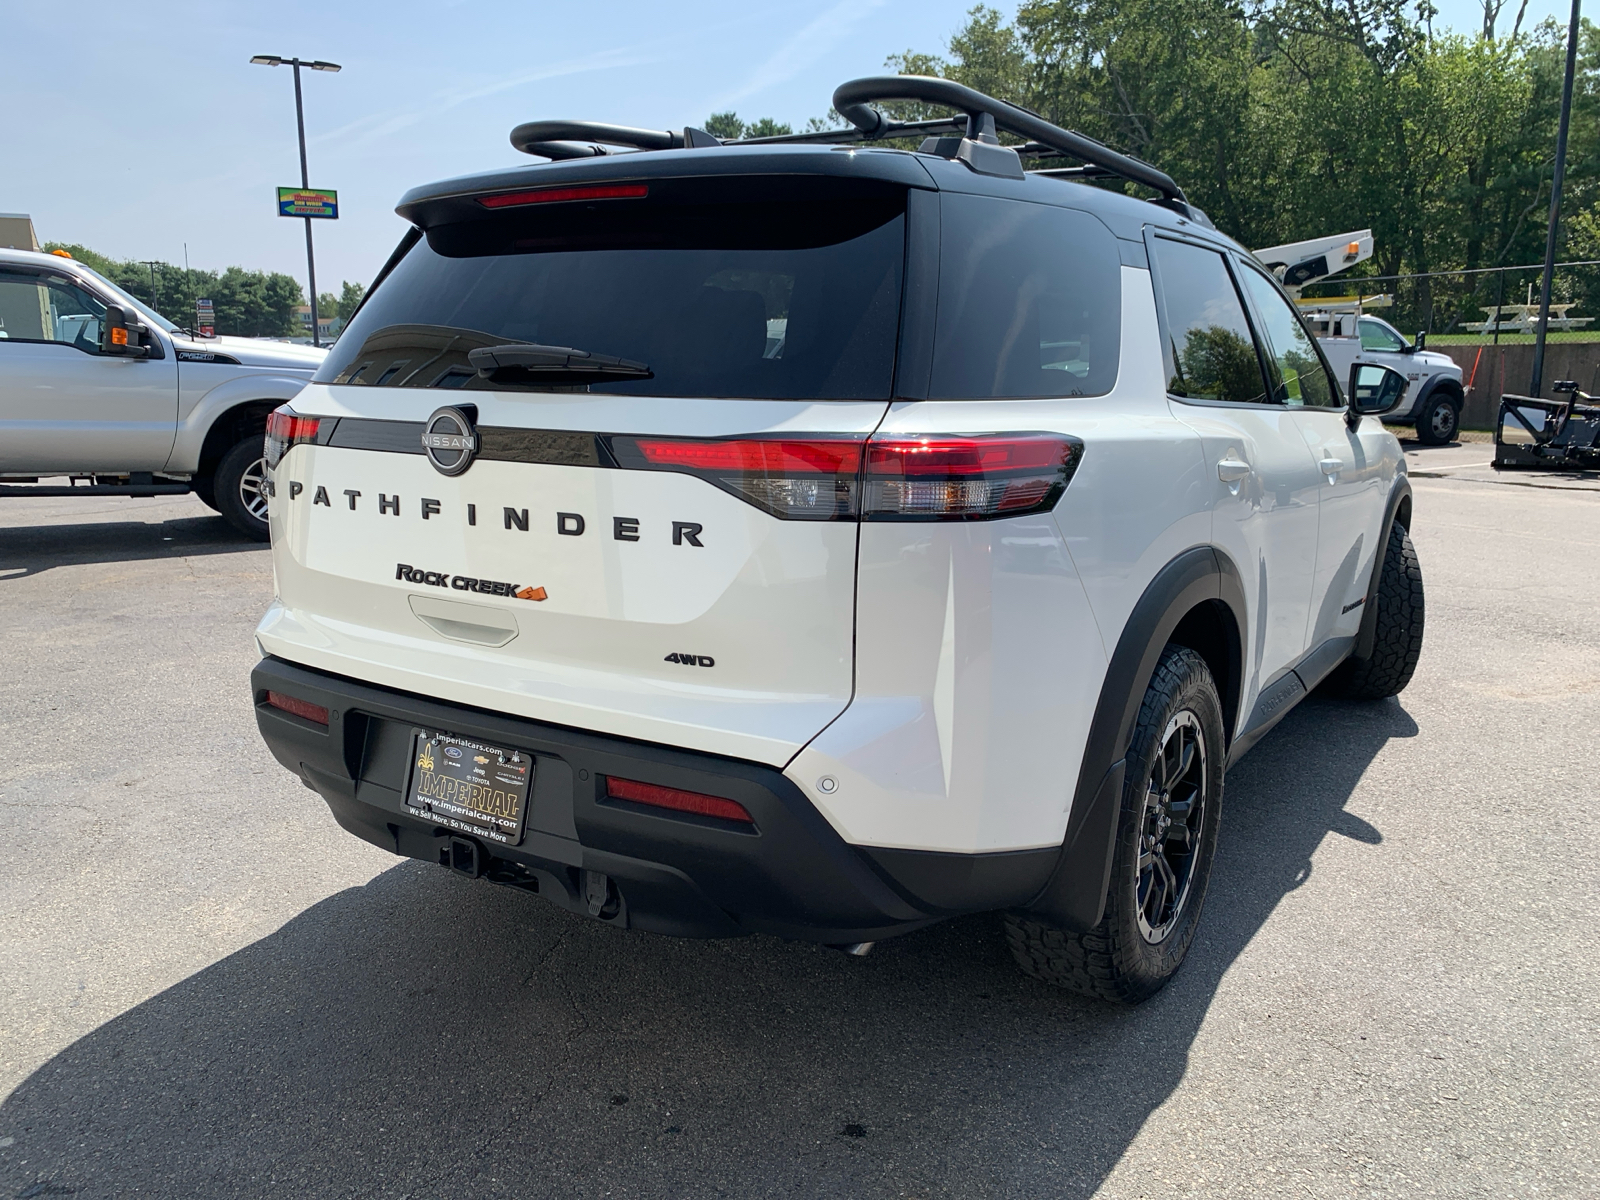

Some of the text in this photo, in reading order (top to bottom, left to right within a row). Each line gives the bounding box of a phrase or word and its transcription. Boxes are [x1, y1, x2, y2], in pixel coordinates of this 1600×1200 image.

[421, 435, 472, 448] NISSAN
[289, 480, 705, 548] PATHFINDER
[395, 563, 520, 598] ROCK CREEK
[663, 652, 715, 668] 4WD
[436, 732, 503, 756] Imperialcars.com
[472, 776, 490, 786] TOYOTA
[473, 766, 486, 776] Jeep
[418, 770, 519, 820] IMPERIAL
[409, 807, 507, 843] We Sell More, So You Save More
